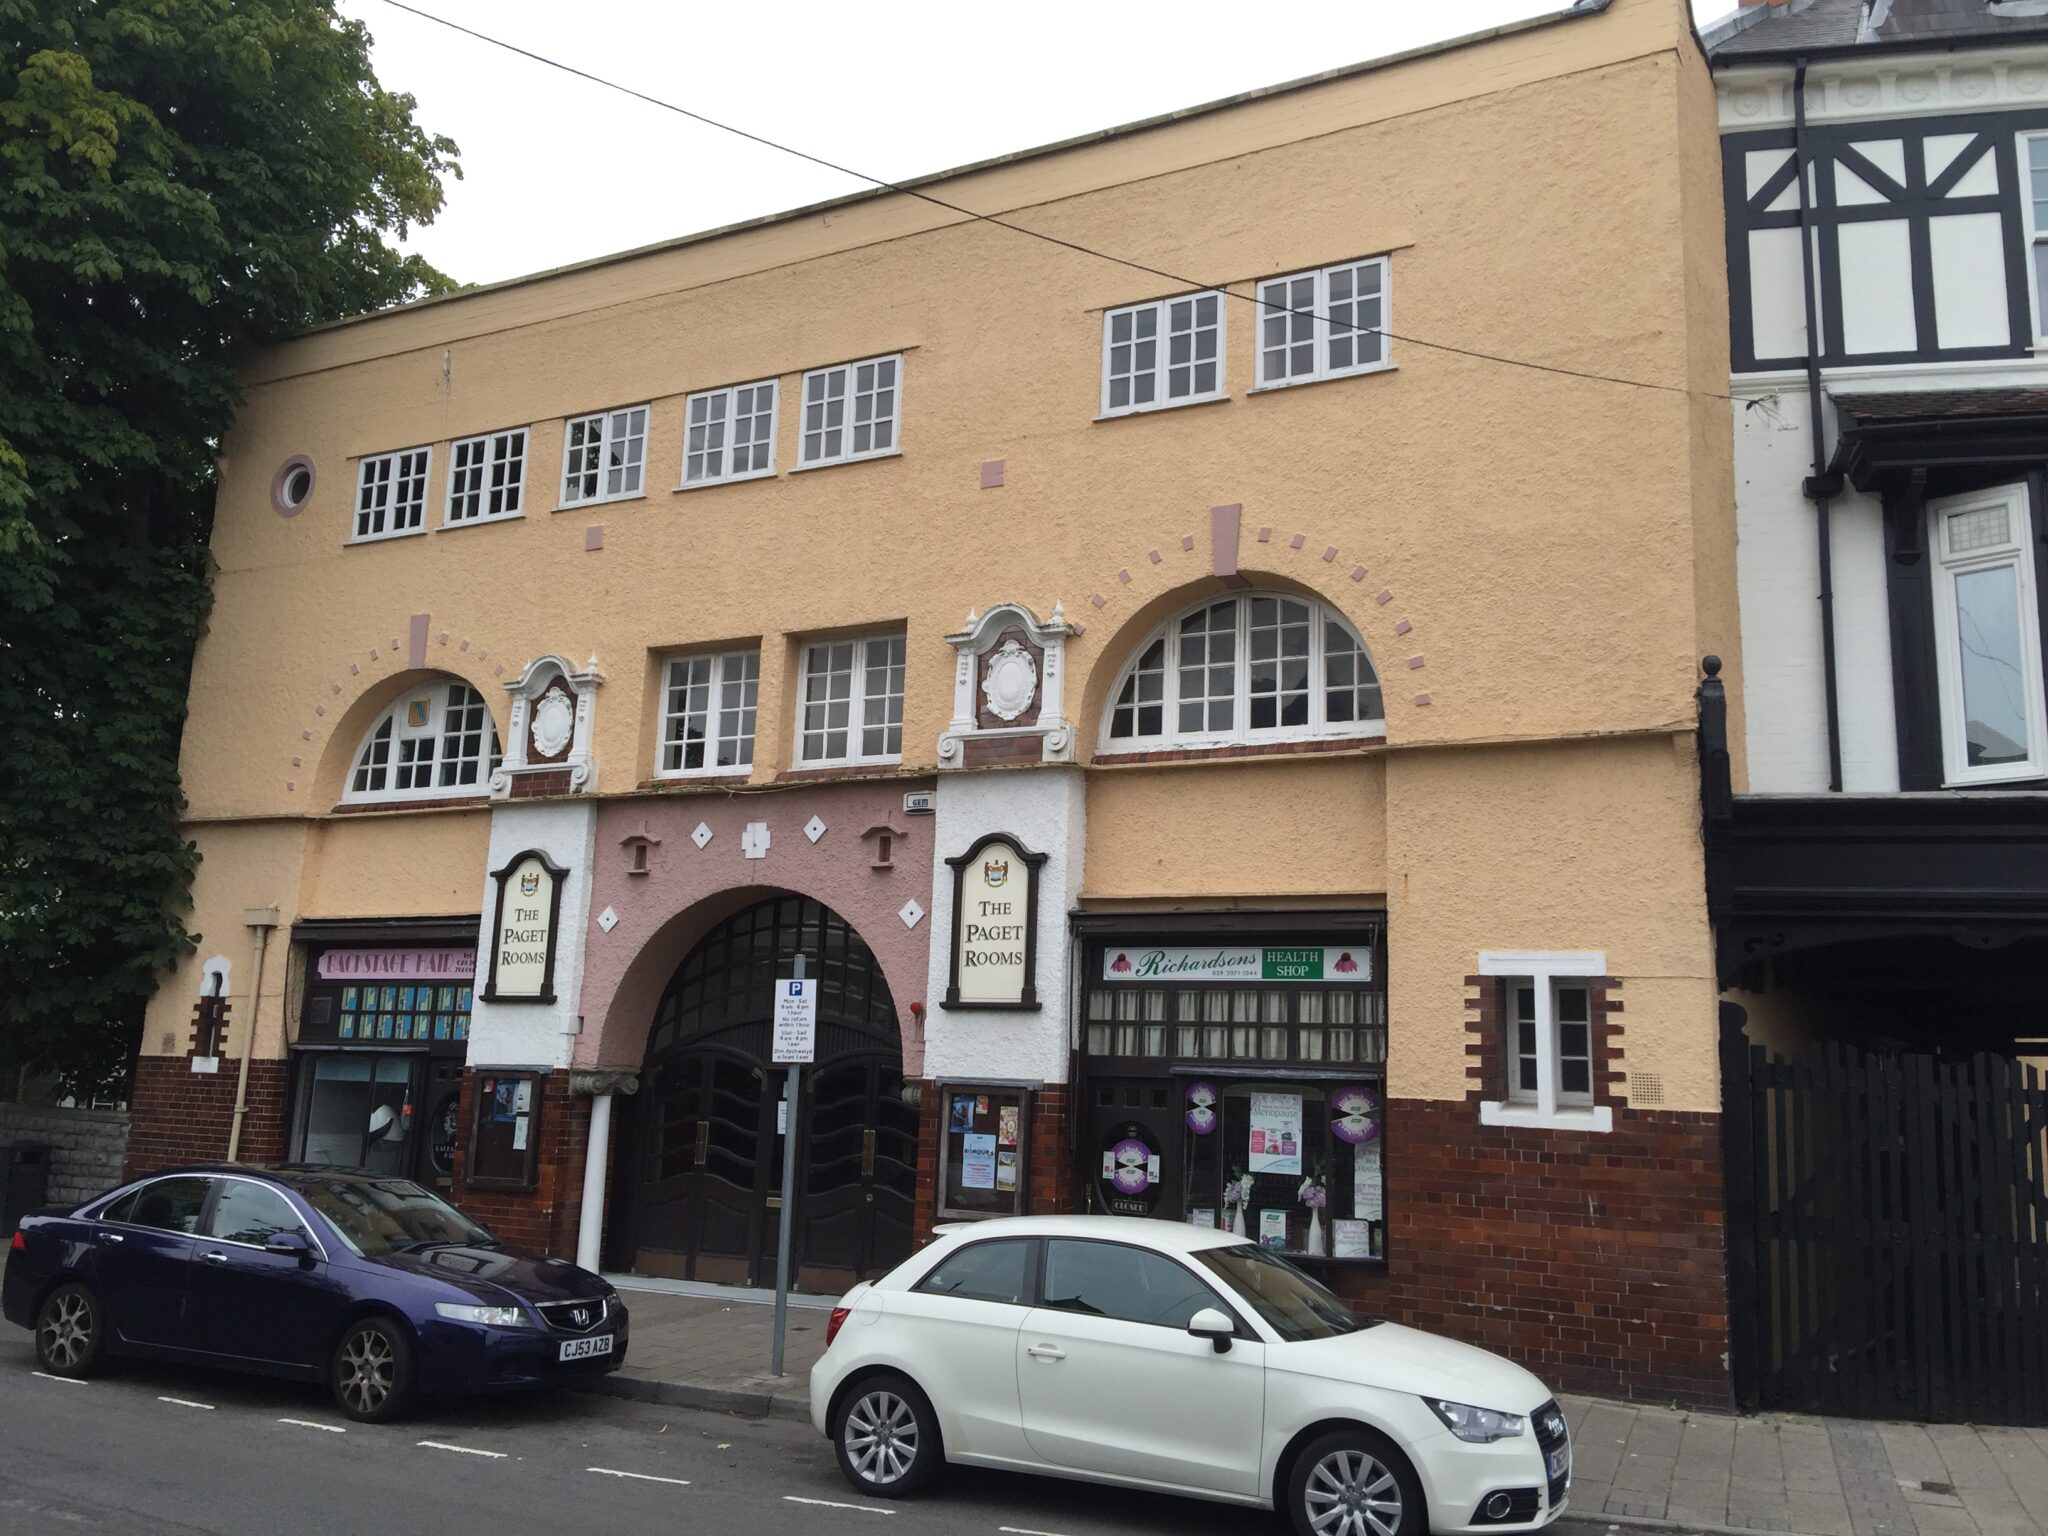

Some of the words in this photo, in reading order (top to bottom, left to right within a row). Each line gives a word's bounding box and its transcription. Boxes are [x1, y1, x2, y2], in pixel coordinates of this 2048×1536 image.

[514, 908, 540, 922] THE
[978, 900, 1012, 917] THE
[503, 928, 547, 945] PAGET
[964, 924, 1024, 943] PAGET
[326, 953, 409, 973] BACKSTAGE
[415, 952, 452, 973] HAIR
[501, 950, 545, 966] ROOMS
[964, 950, 1023, 967] ROOMS
[1135, 950, 1256, 977] Richardsons
[1267, 951, 1319, 962] HEALTH
[1276, 965, 1309, 977] SHOP
[791, 982, 801, 995] P
[1252, 1107, 1299, 1119] Menopause
[564, 1341, 591, 1358] CJ53
[593, 1337, 610, 1354] AZB
